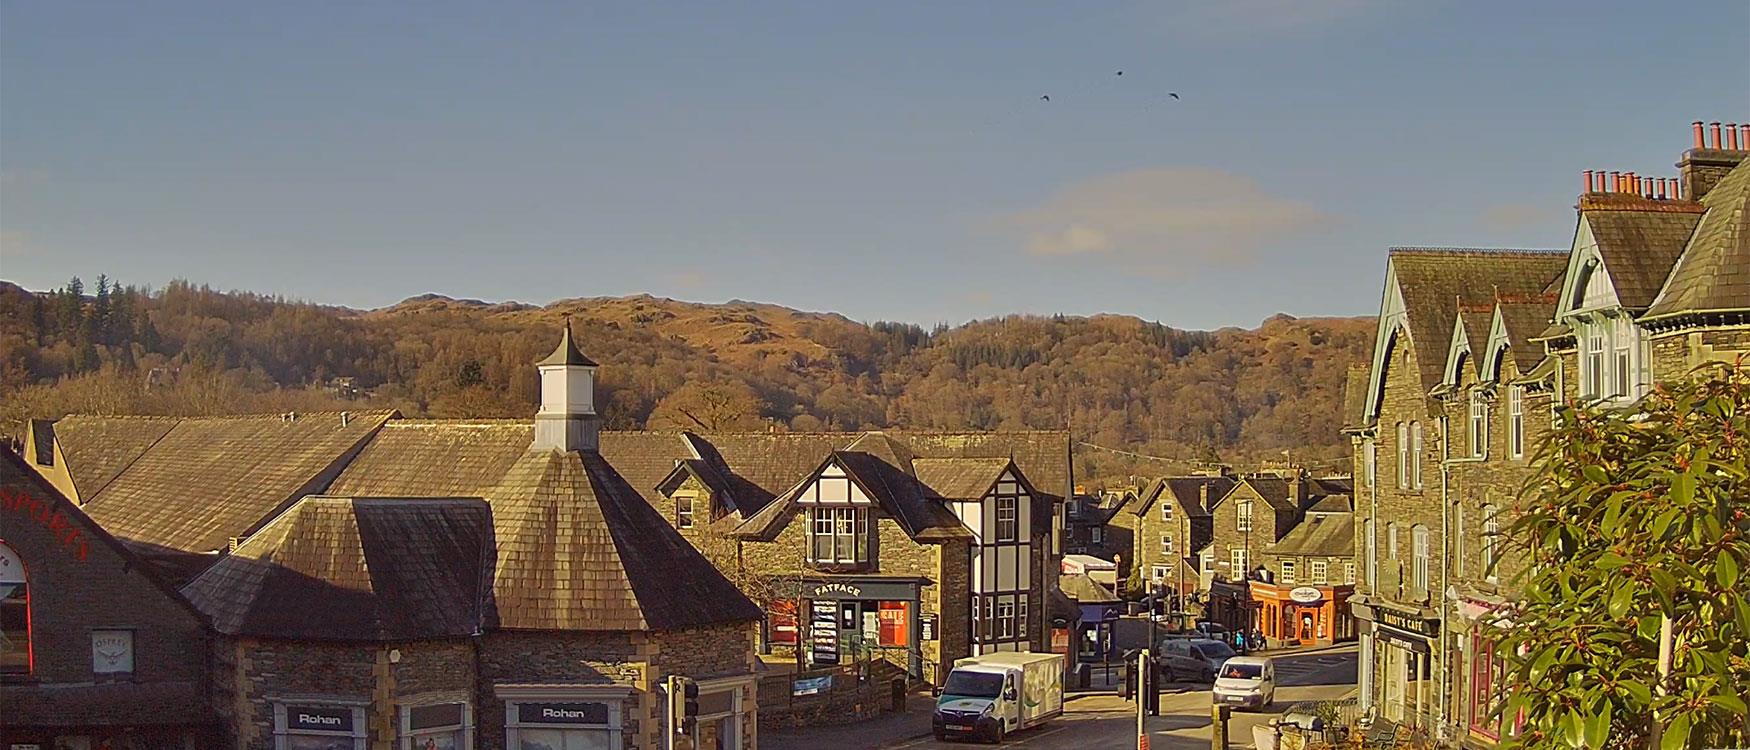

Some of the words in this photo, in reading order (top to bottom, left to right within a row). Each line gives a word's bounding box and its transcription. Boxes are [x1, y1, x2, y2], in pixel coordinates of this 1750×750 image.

[814, 584, 861, 597] FATFACE
[543, 708, 585, 718] Rohan
[299, 714, 341, 725] Rohan
